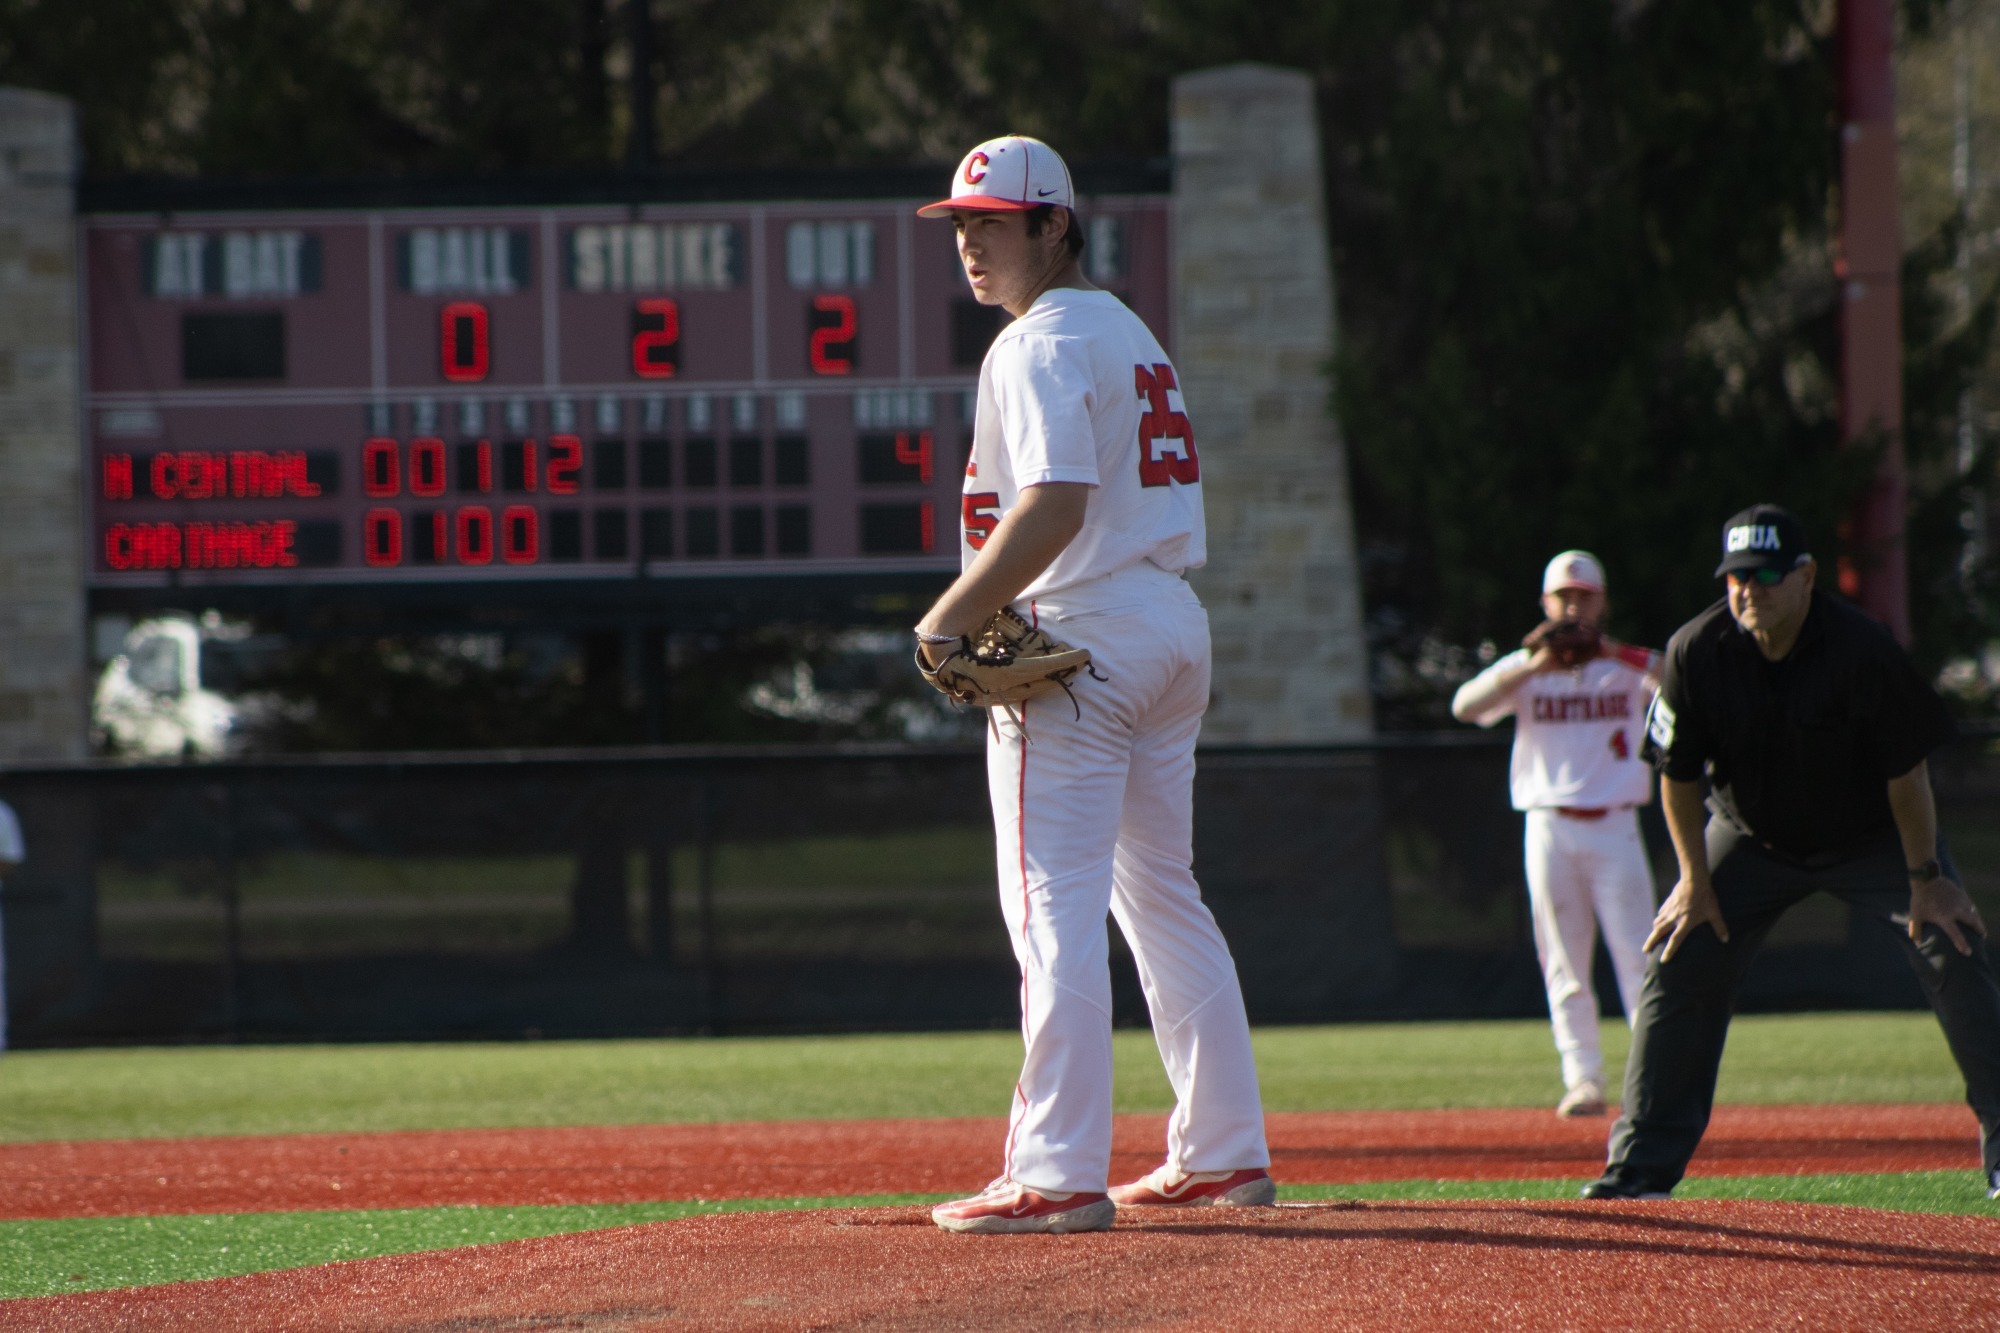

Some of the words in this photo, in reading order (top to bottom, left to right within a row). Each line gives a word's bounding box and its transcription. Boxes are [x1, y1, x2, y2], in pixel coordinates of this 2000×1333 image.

[964, 152, 990, 184] C
[575, 223, 732, 292] STRIKE
[786, 220, 874, 290] OUT
[441, 301, 490, 382] 0
[632, 298, 679, 379] 2
[810, 294, 857, 375] 2
[1134, 363, 1200, 488] 25
[364, 437, 400, 497] 0
[409, 437, 447, 496] 0
[546, 434, 583, 494] 2
[895, 431, 933, 484] 4
[106, 519, 298, 570] CARTHAGE
[365, 507, 402, 567] 0
[455, 505, 493, 565] 0
[502, 504, 540, 564] 0
[1727, 525, 1781, 552] CBUA
[1534, 692, 1629, 723] CARTHAGE
